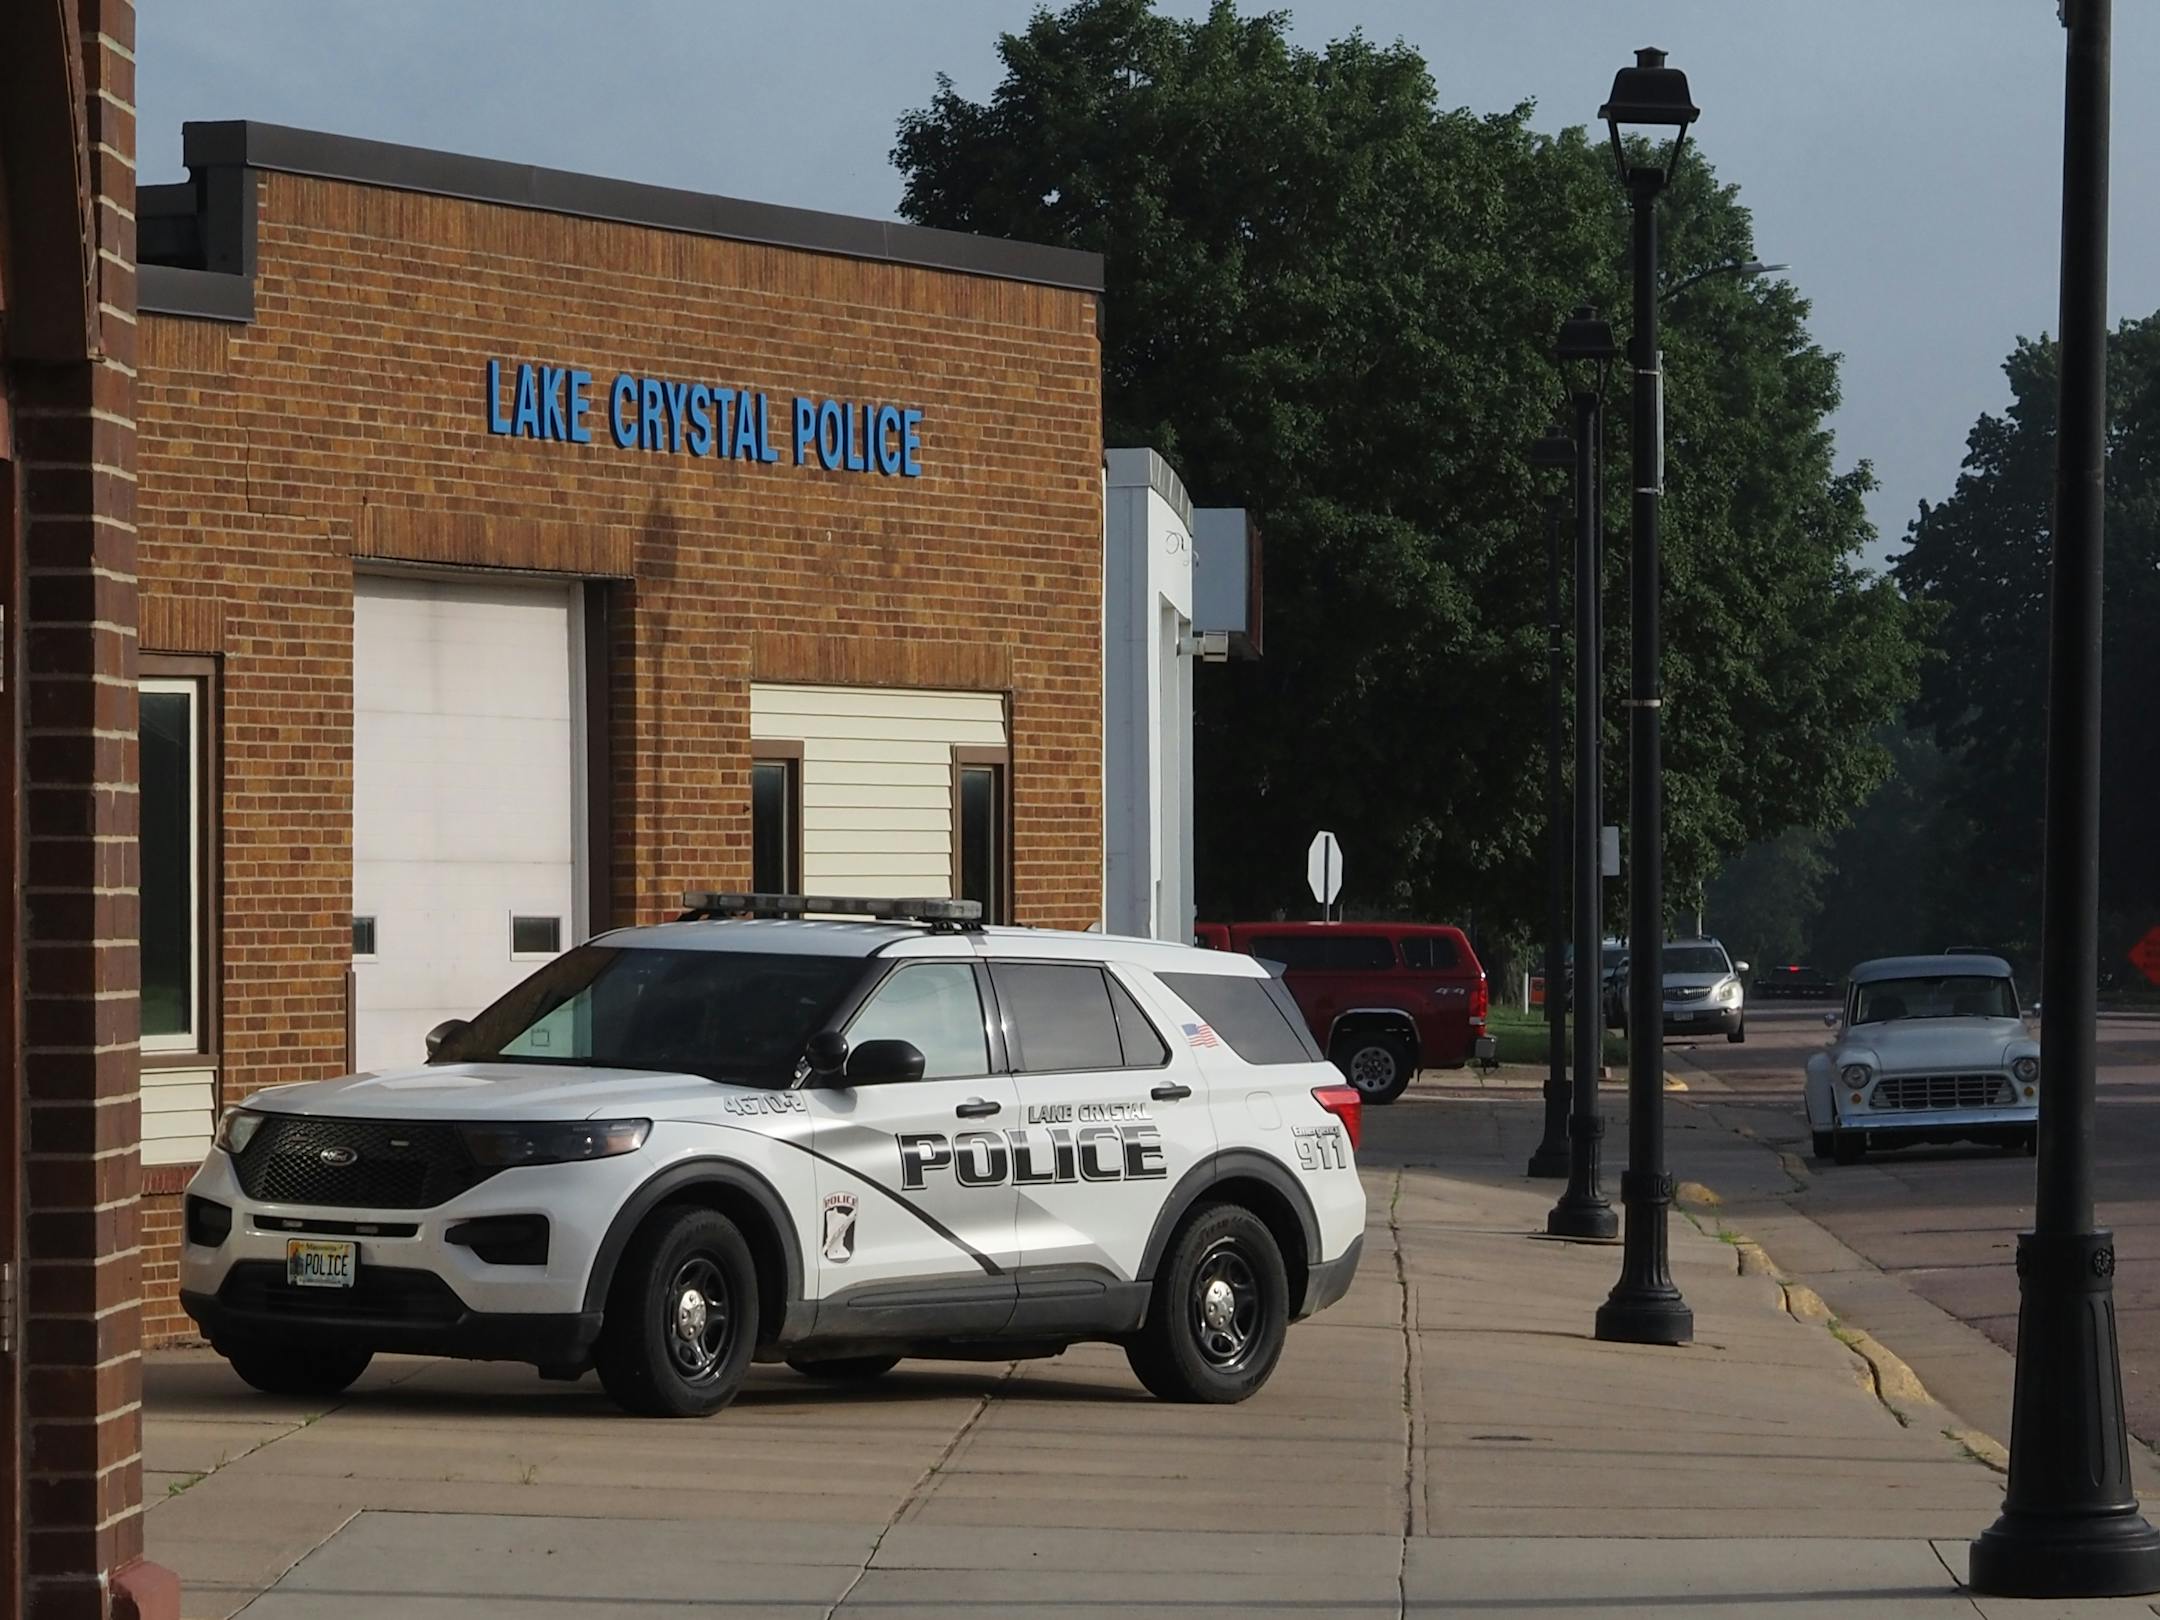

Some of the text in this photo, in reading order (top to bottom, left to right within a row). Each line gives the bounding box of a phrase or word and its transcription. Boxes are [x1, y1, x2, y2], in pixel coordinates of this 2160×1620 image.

[487, 359, 924, 477] LAKE CRYSTAL POLICE
[1028, 1102, 1153, 1124] LAKE CRYSTAL
[895, 1125, 1168, 1191] POLICE
[1294, 1138, 1347, 1170] 911
[824, 1194, 855, 1209] POLICE
[304, 1253, 349, 1277] POLICE
